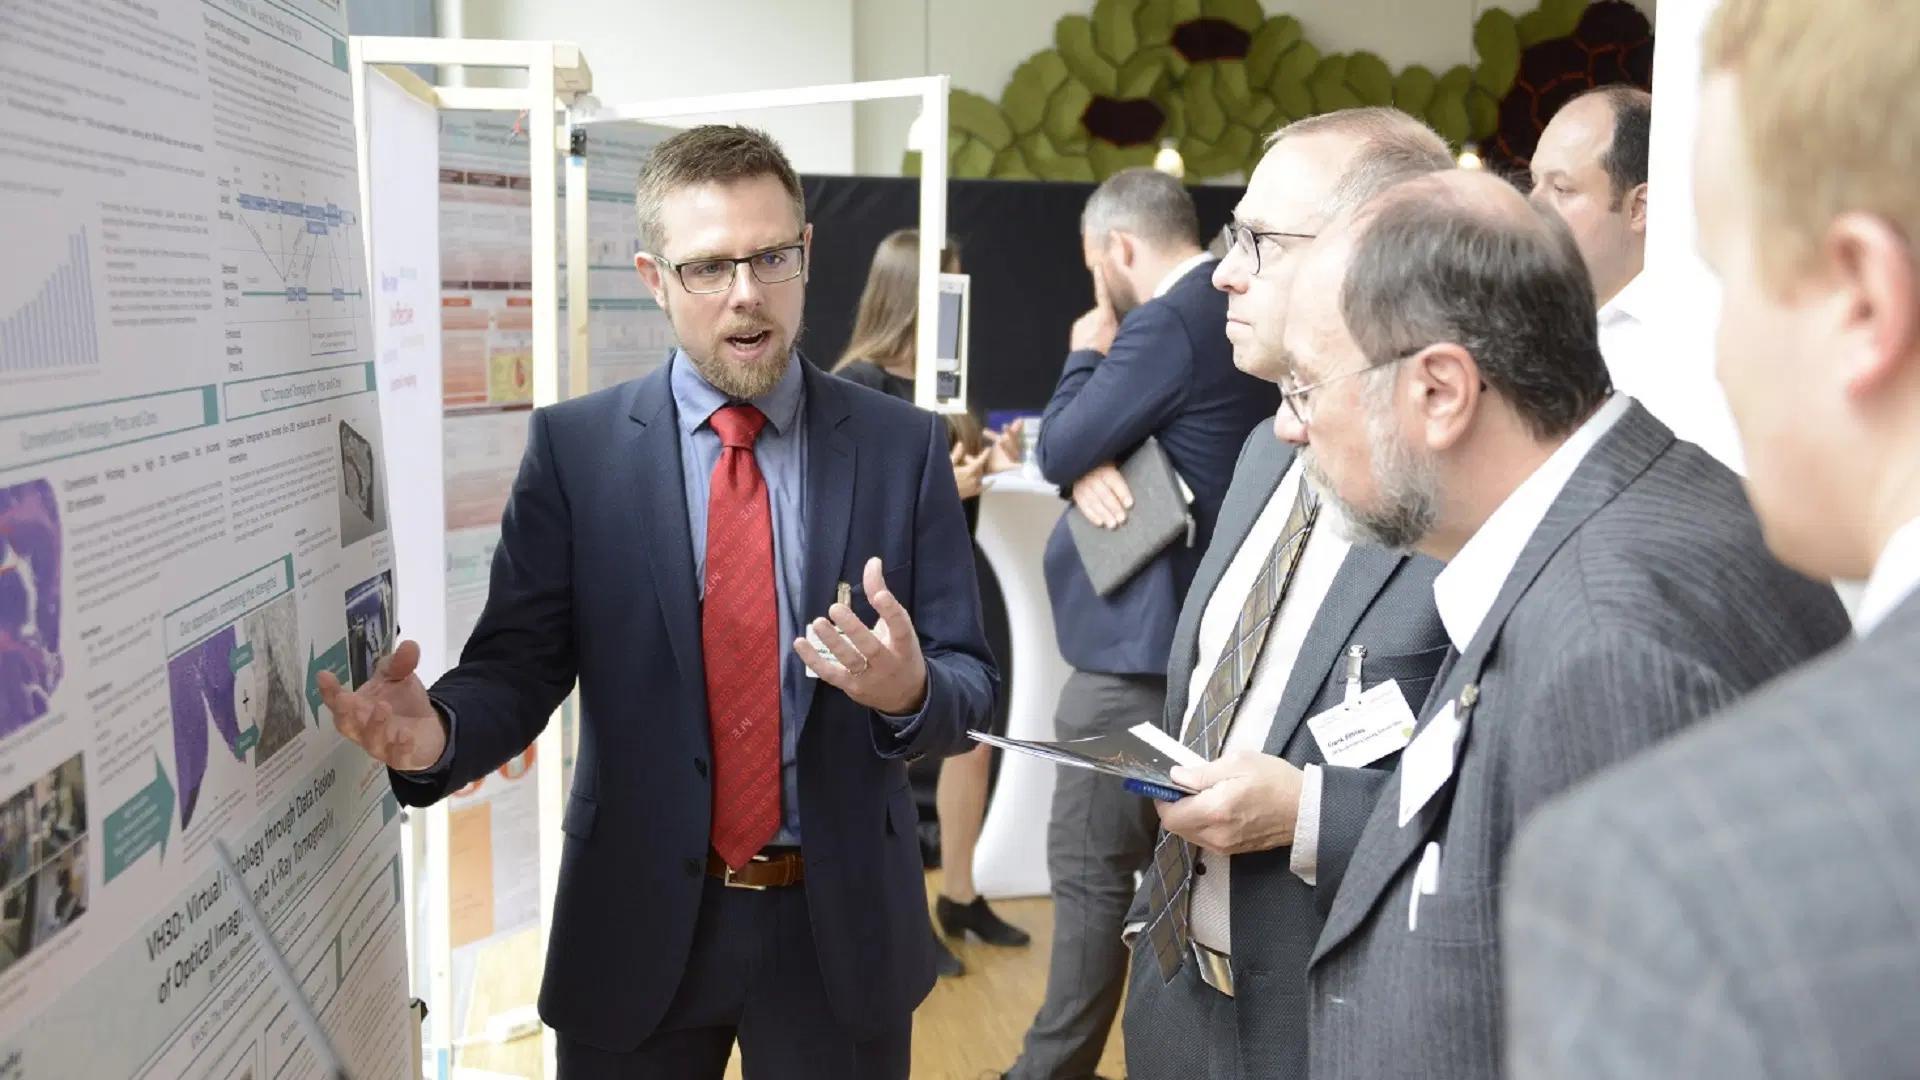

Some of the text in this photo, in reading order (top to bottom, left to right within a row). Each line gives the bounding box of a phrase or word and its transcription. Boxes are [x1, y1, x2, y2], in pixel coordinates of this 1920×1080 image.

[186, 870, 222, 924] Virtual
[264, 802, 296, 850] through
[296, 789, 314, 818] Data
[313, 767, 336, 802] Fusion
[158, 966, 172, 1004] of
[174, 927, 213, 989] Optical
[269, 853, 293, 891] X-Ray
